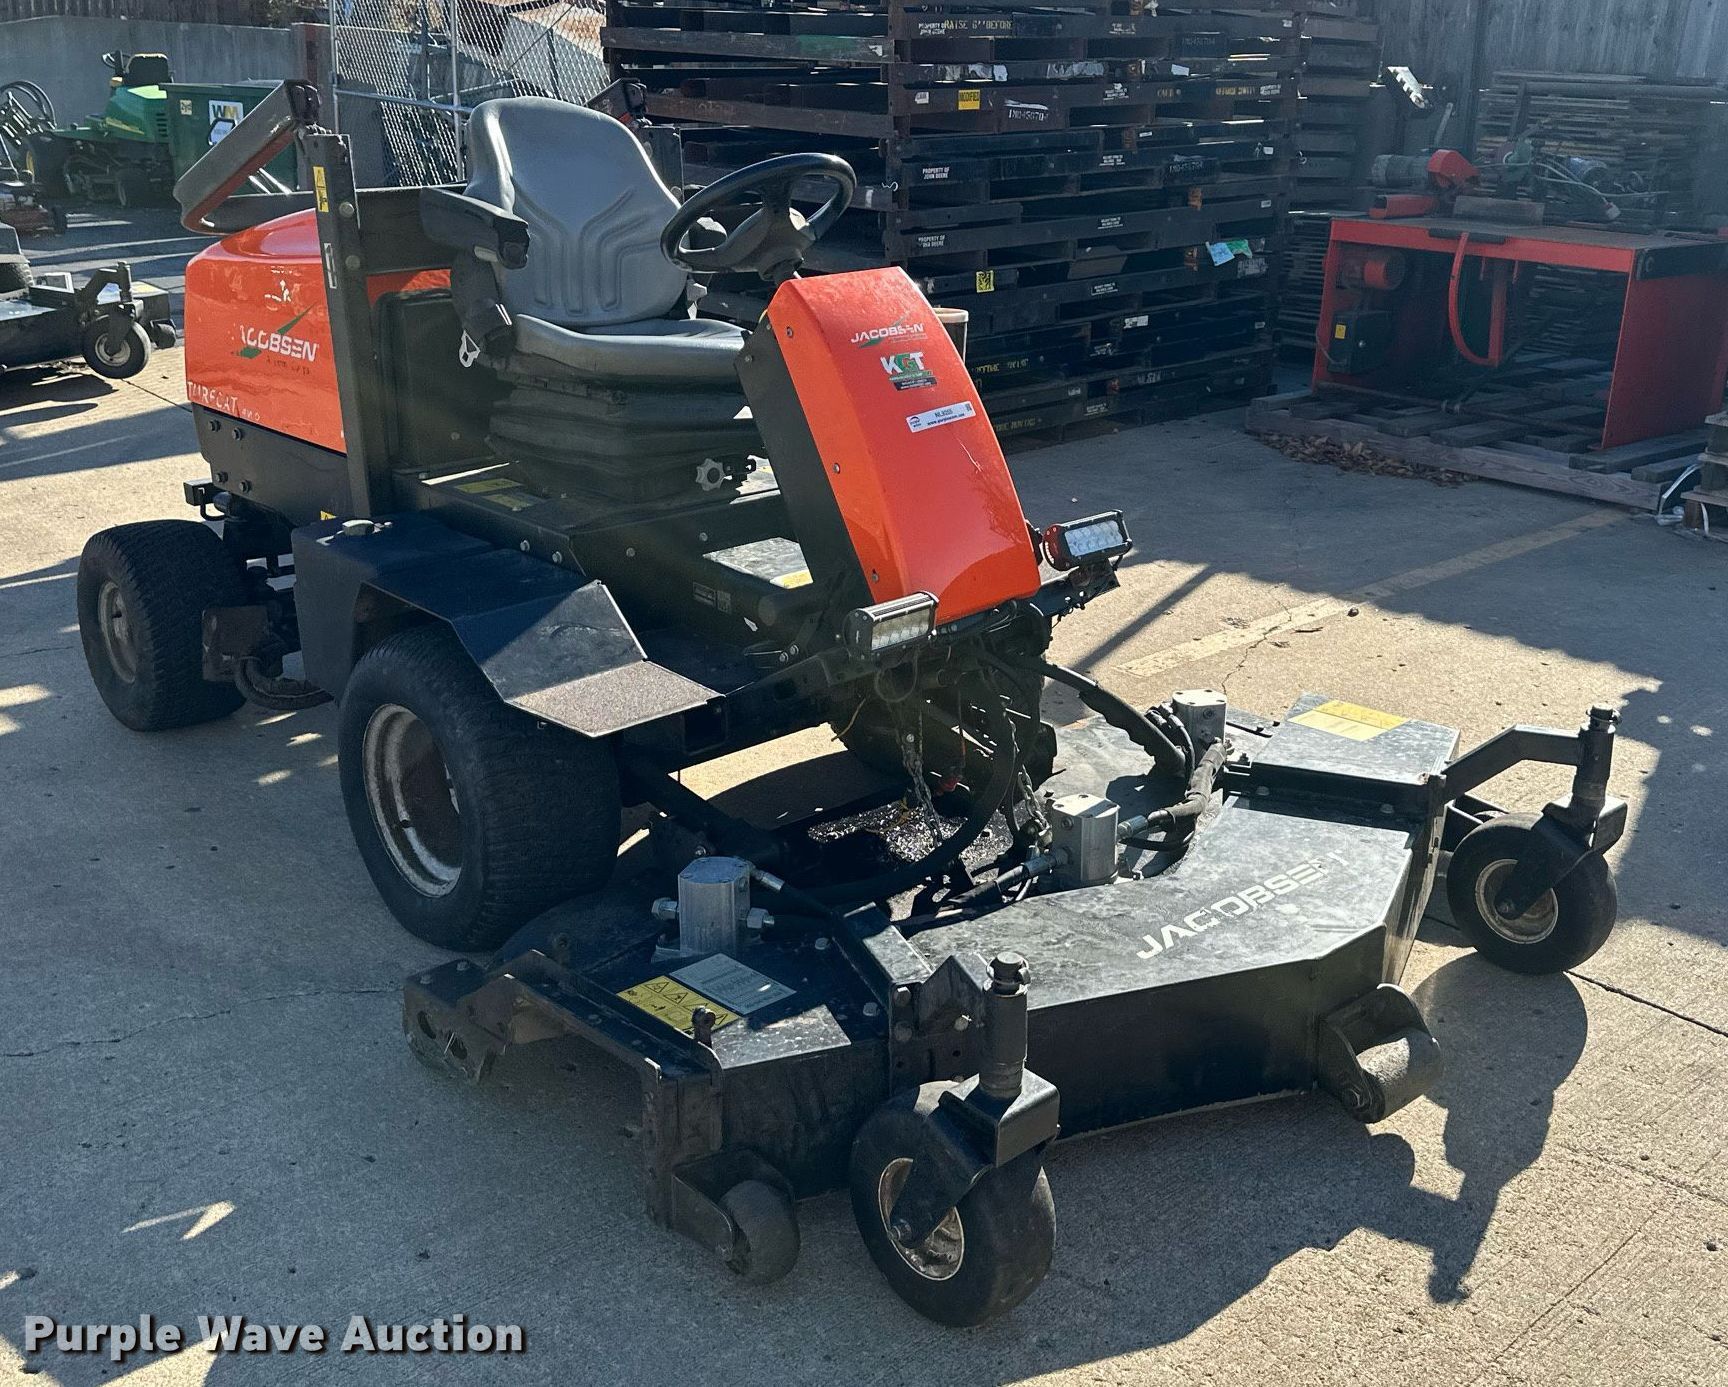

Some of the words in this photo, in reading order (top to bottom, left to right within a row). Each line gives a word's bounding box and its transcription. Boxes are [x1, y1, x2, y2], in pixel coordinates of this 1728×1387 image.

[944, 19, 968, 29] RAISE
[211, 104, 239, 120] WM
[880, 352, 925, 374] KGT
